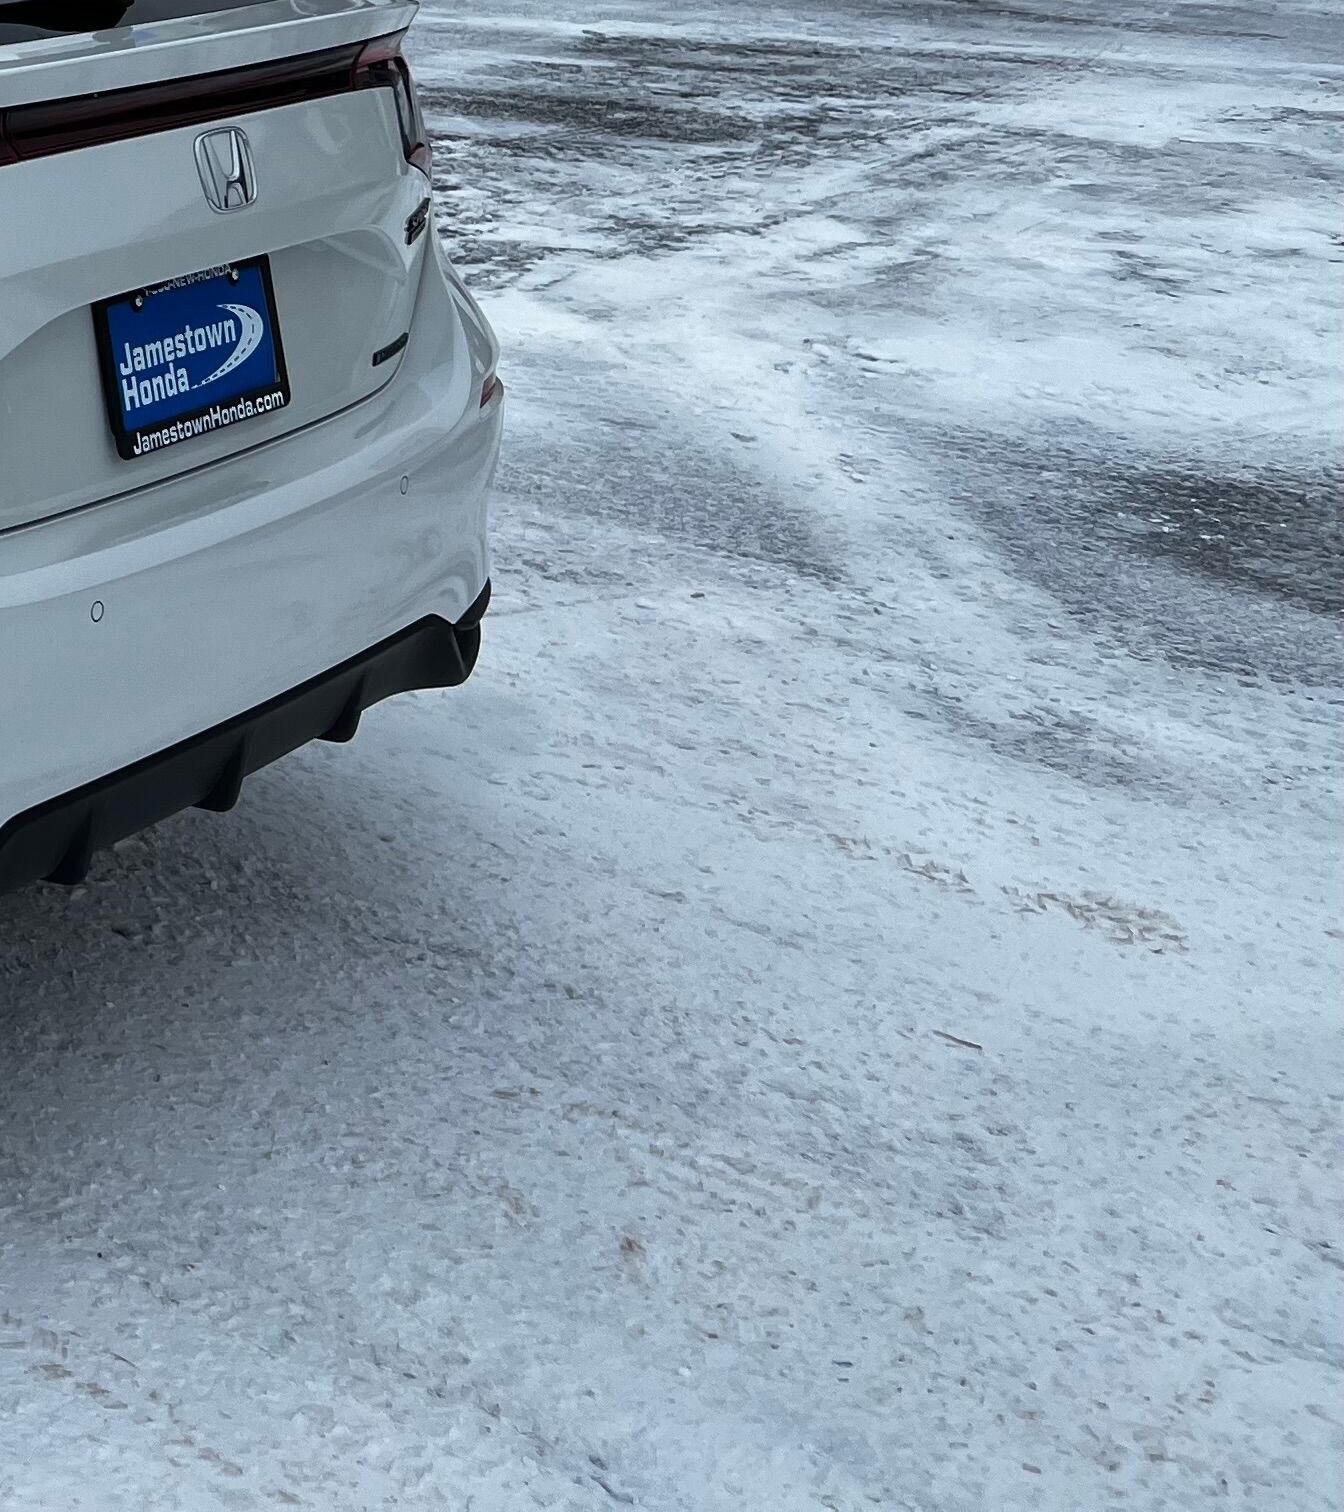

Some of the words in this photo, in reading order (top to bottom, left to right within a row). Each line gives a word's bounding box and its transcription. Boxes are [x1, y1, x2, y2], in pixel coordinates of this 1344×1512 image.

[119, 318, 236, 376] Jamestown
[121, 363, 190, 411] Honda
[133, 390, 285, 455] JamestownHonda.com
